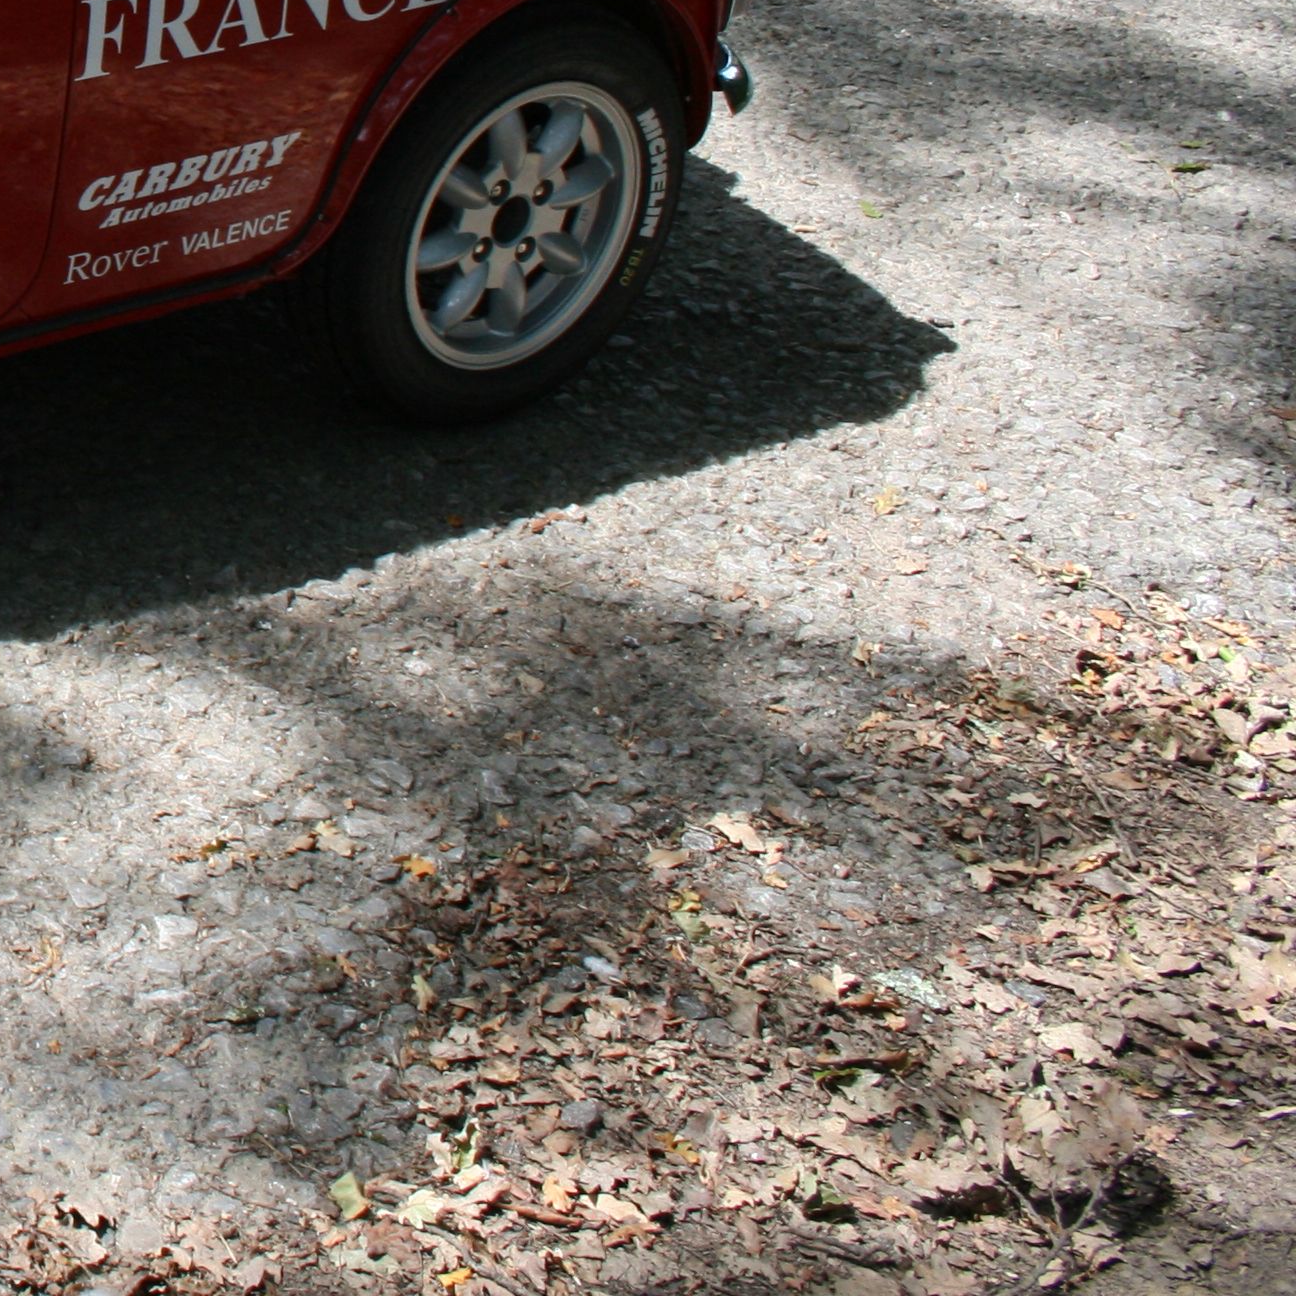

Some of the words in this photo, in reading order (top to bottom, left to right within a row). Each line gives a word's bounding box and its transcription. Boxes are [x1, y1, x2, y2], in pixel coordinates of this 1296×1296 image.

[77, 131, 303, 212] CARBURY
[98, 175, 272, 230] Automobiles
[636, 107, 669, 238] MICHELIN
[62, 236, 169, 286] Rover
[181, 209, 293, 257] VALENCE
